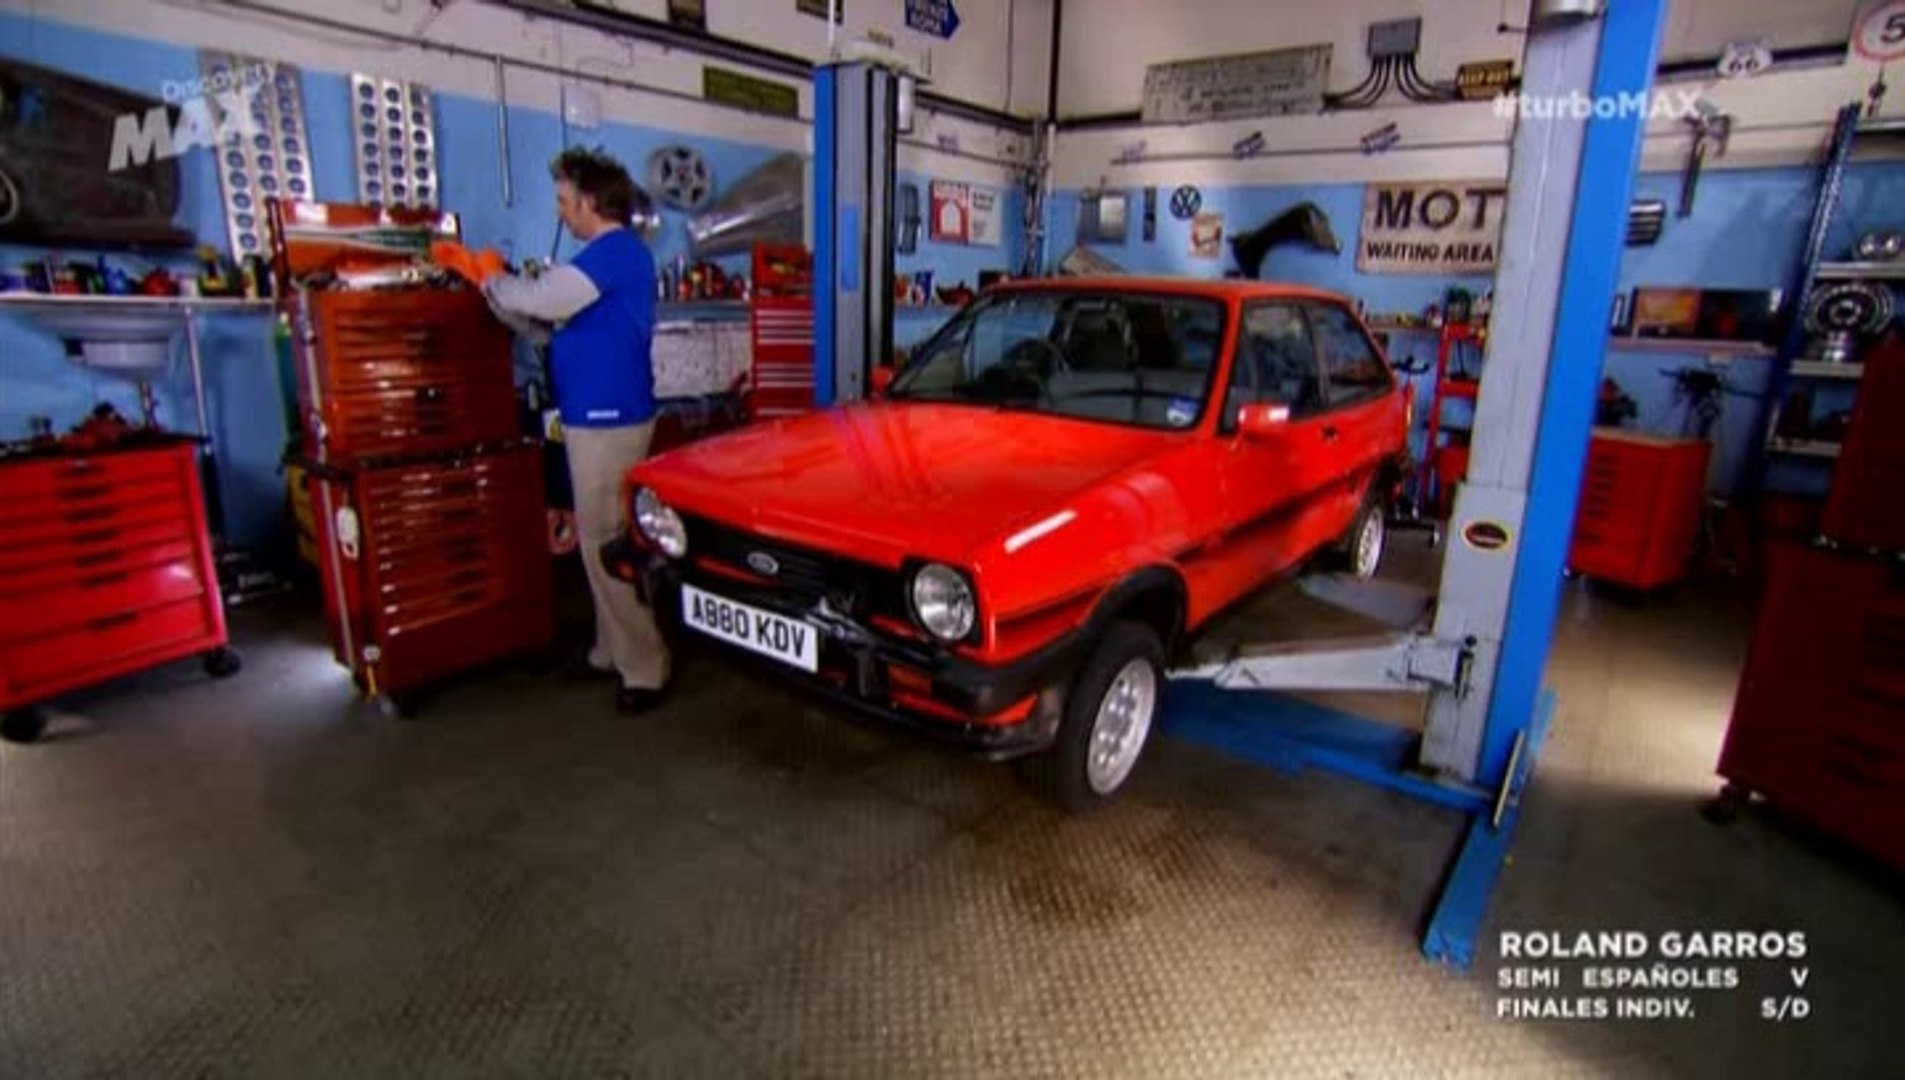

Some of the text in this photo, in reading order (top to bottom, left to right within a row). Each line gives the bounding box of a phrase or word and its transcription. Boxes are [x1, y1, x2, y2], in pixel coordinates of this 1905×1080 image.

[1729, 58, 1758, 73] 66
[1374, 186, 1506, 230] MOT
[1367, 240, 1494, 262] WAITING AREA
[755, 613, 806, 658] KDV
